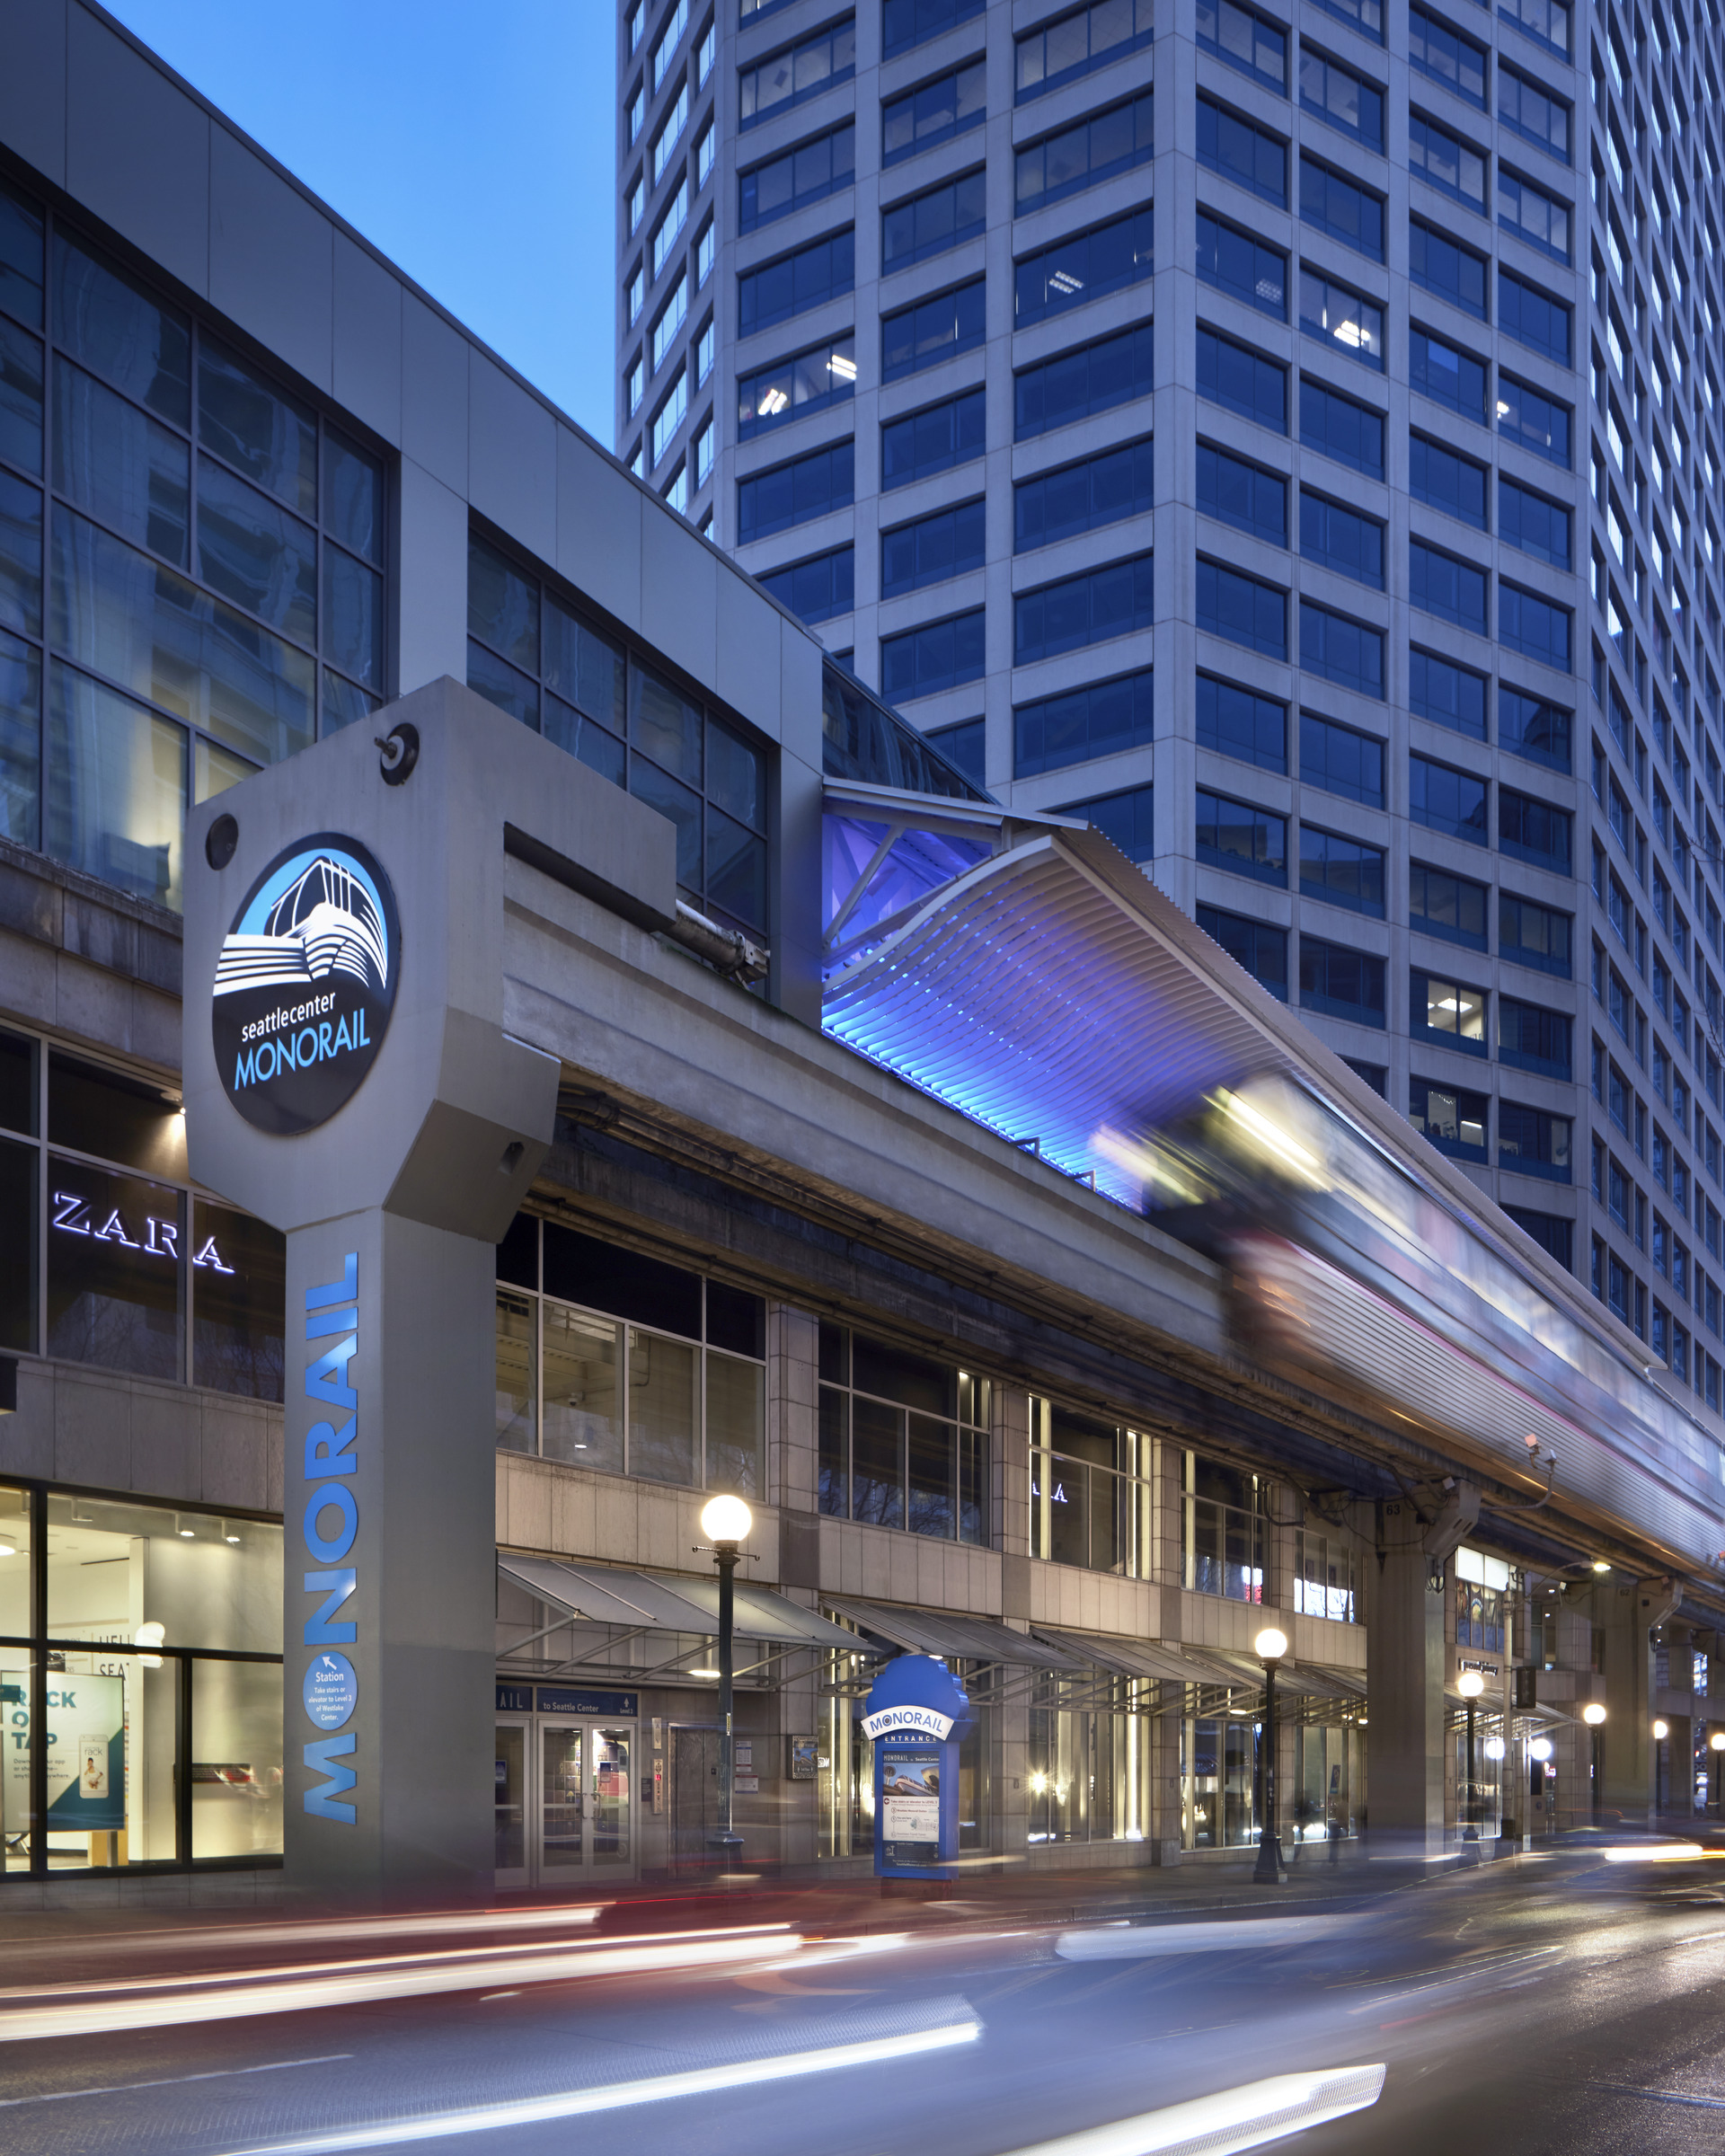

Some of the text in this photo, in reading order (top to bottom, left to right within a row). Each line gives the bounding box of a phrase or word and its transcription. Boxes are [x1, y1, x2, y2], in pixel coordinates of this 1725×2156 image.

[234, 1008, 370, 1091] MONORAIL
[54, 1192, 235, 1274] ZARA
[1386, 1505, 1401, 1515] 63
[315, 1671, 344, 1683] Station
[12, 1691, 76, 1708] RCK
[494, 1692, 523, 1709] AIL
[543, 1701, 599, 1712] to Seattle Center
[870, 1711, 942, 1733] MONORAIL
[12, 1732, 58, 1749] TP
